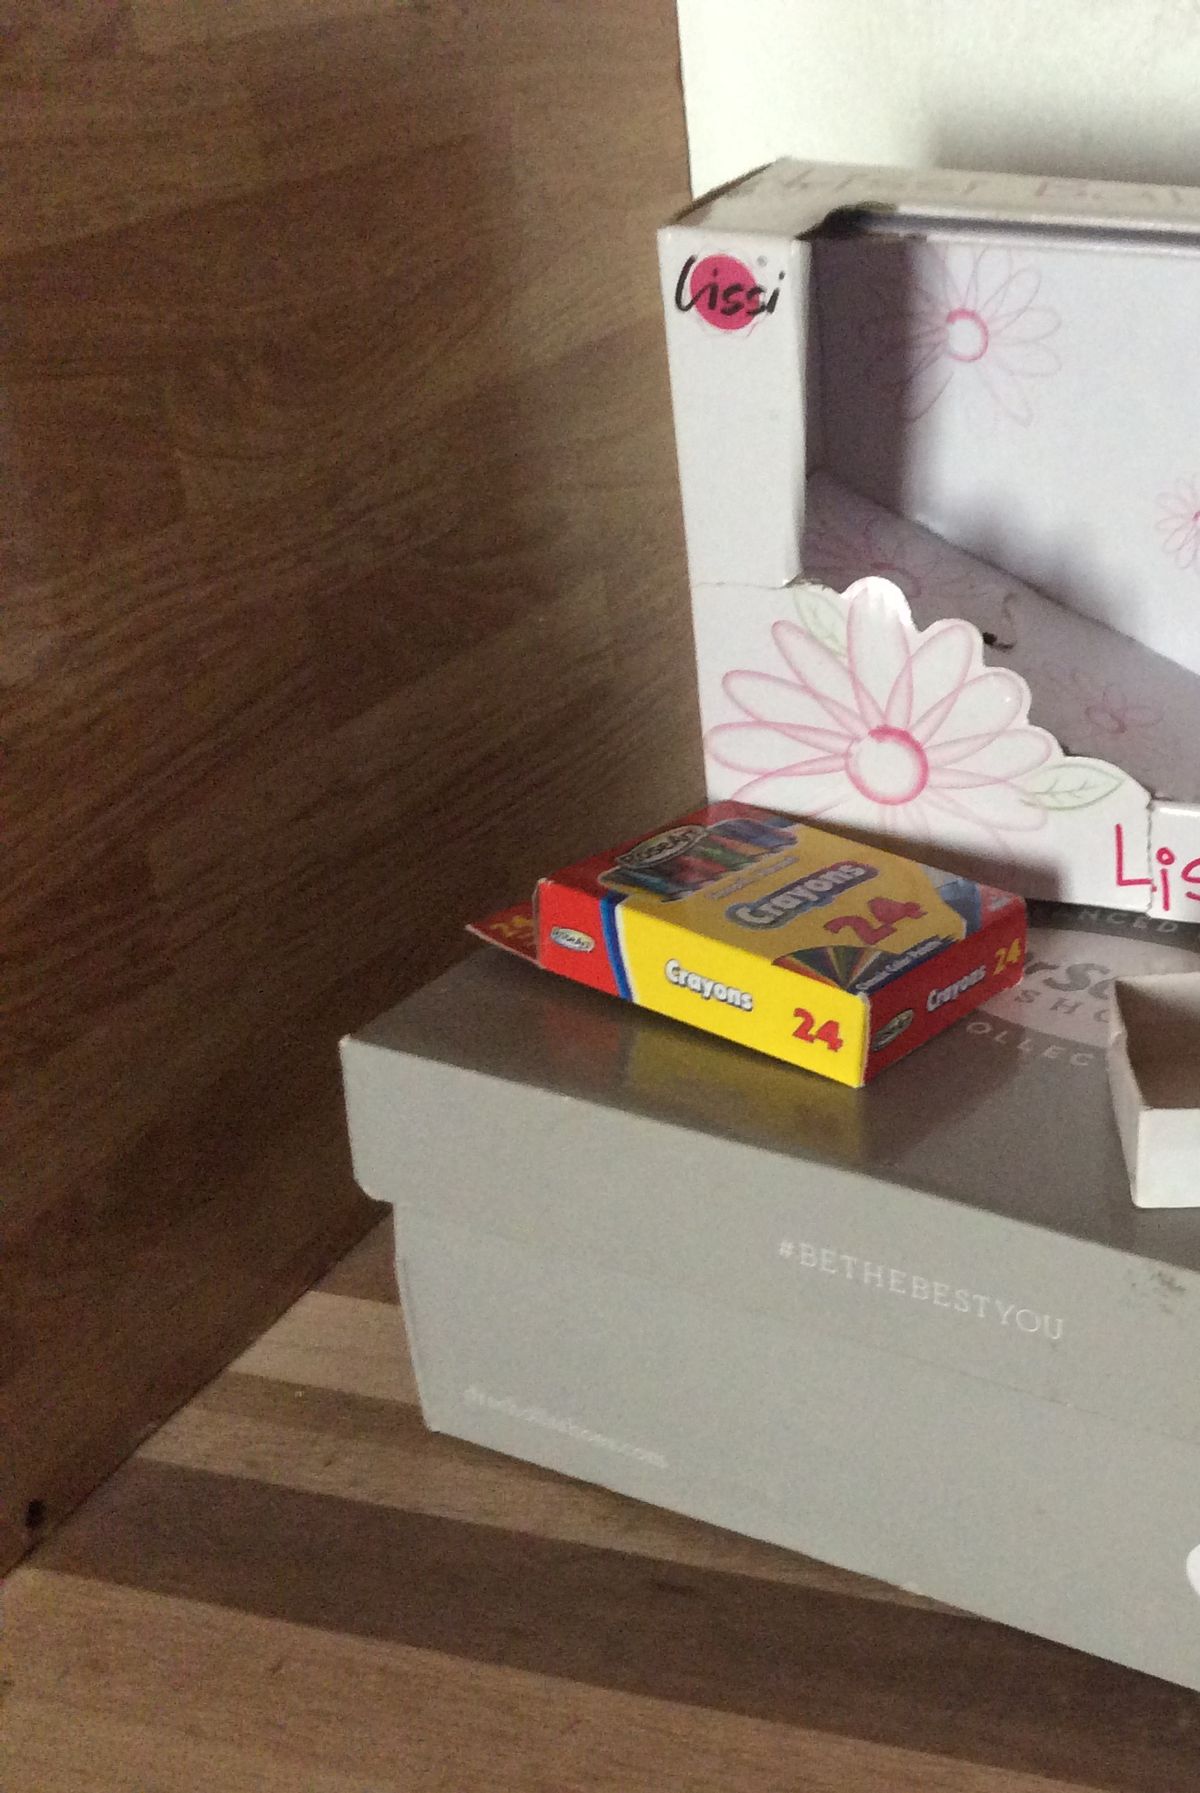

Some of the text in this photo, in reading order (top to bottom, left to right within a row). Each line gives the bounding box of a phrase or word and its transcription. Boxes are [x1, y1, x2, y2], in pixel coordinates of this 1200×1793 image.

[675, 254, 785, 316] Lissi
[735, 864, 867, 925] Crayons
[823, 897, 928, 946] 24
[664, 958, 753, 1012] Crayons
[793, 1007, 844, 1052] 24
[926, 964, 988, 1012] Crayons
[992, 938, 1022, 976] 24
[777, 1239, 1065, 1341] #BETHEBESTYOU
